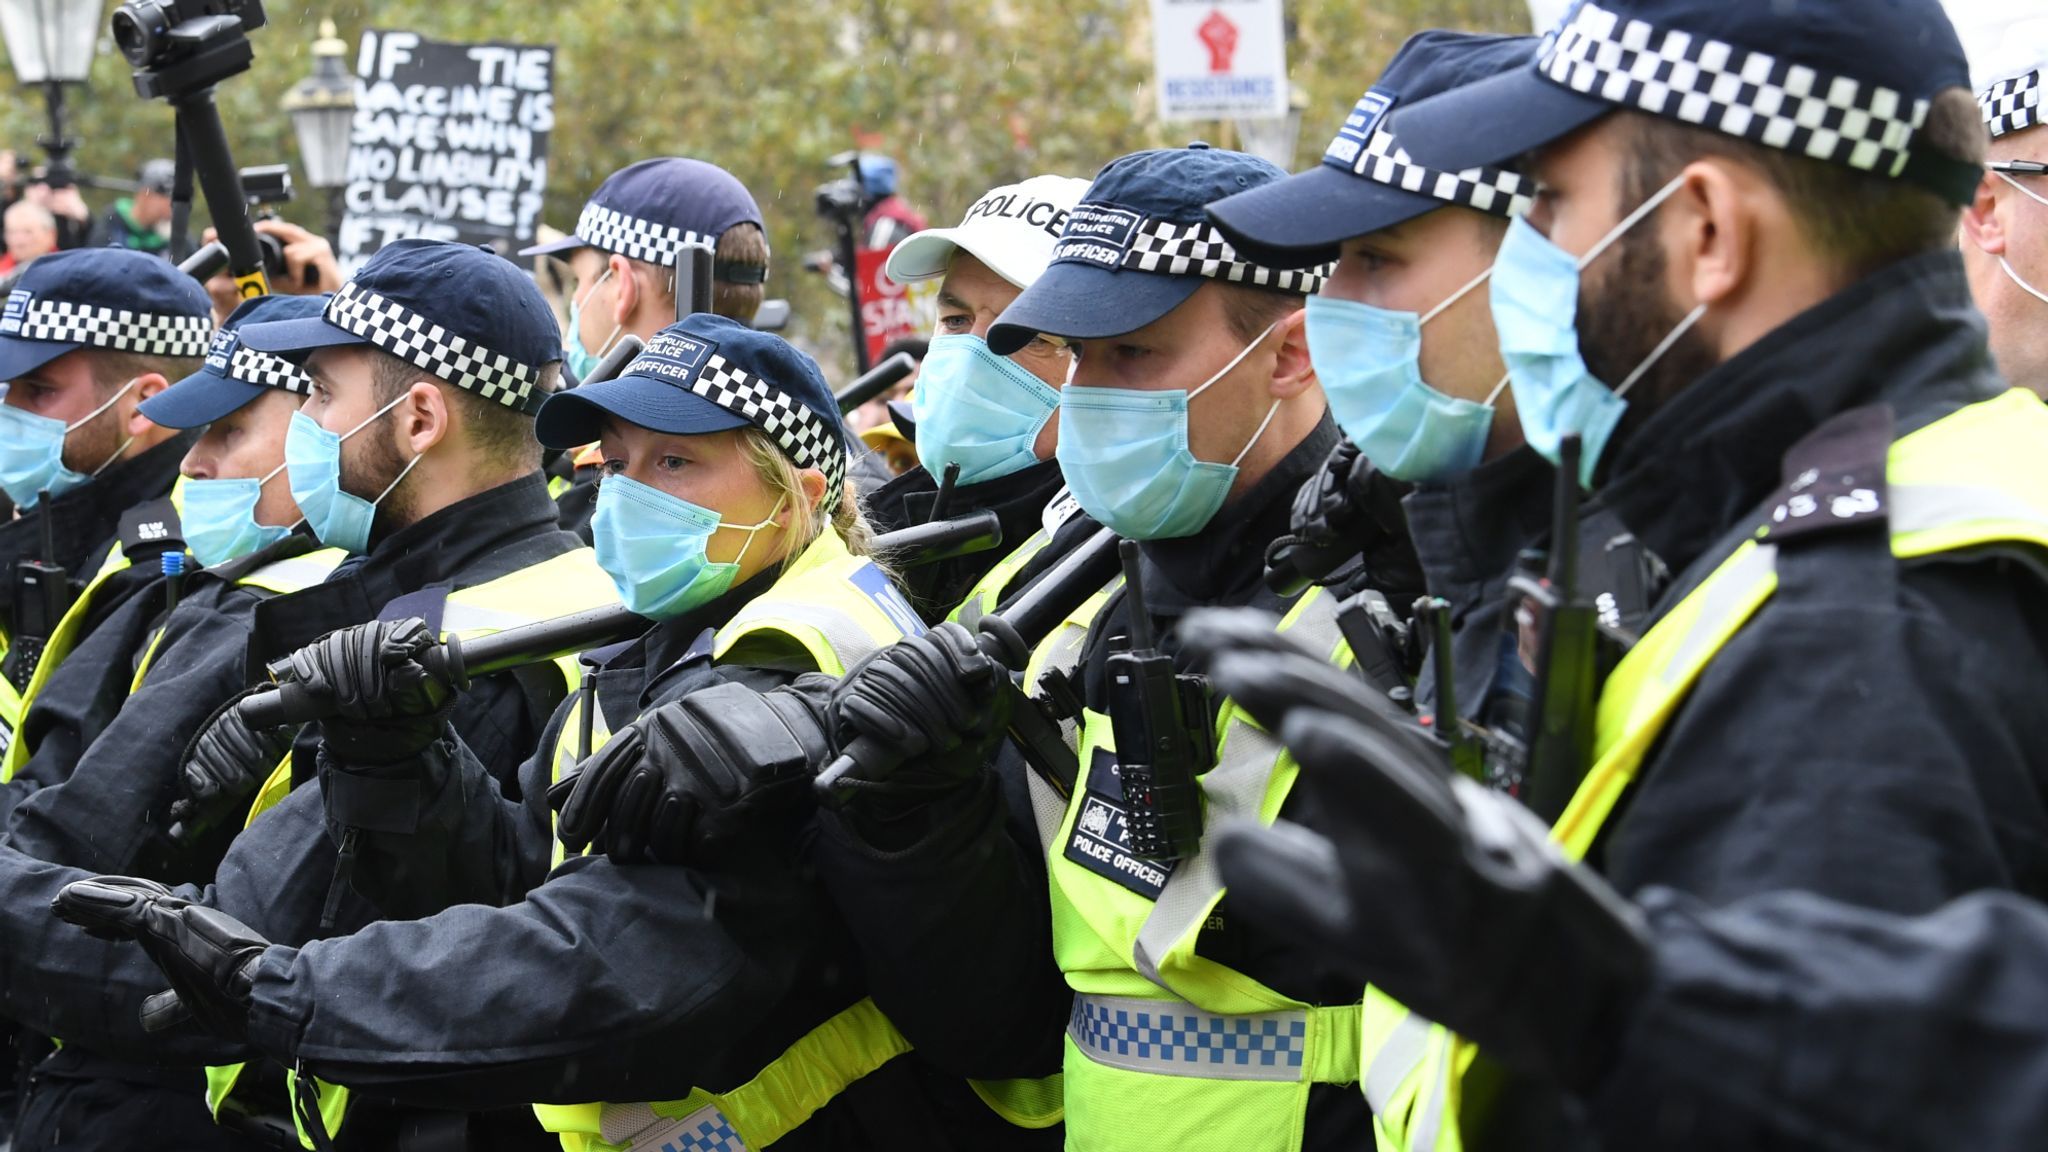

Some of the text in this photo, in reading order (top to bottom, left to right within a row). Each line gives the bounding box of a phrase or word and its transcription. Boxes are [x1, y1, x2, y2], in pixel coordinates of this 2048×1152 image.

[358, 31, 551, 91] IF THE
[353, 79, 555, 132] VACCINE IS
[351, 110, 533, 162] SAFE WHY
[346, 145, 546, 194] NO LIABILITY
[1069, 222, 1115, 235] POLICE
[1060, 243, 1120, 265] OFFICER
[637, 361, 688, 379] OFFICER
[642, 344, 684, 357] POLICE
[1073, 835, 1114, 864] POLICE
[1113, 853, 1166, 888] OFFICER
